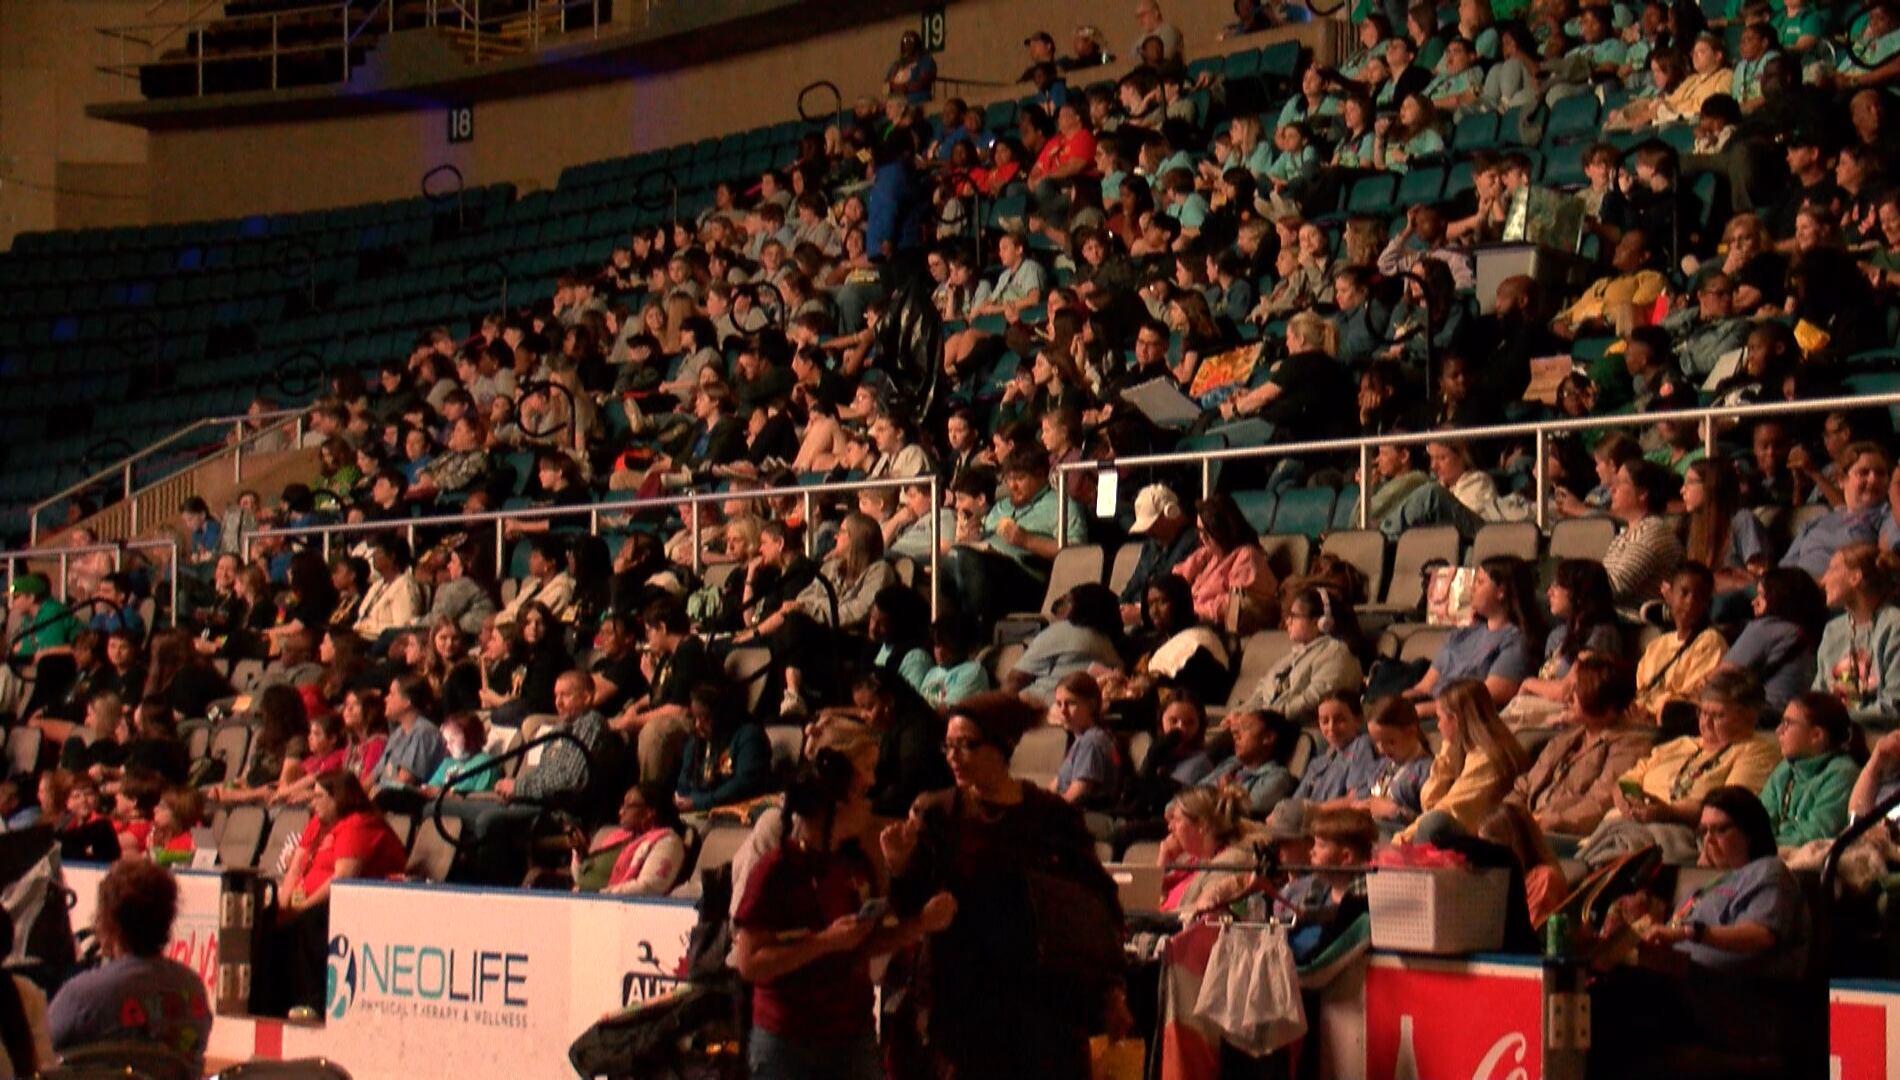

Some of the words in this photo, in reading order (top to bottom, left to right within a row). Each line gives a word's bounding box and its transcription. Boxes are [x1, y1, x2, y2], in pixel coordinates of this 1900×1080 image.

[924, 13, 944, 49] 19
[452, 107, 472, 139] 18
[361, 942, 529, 1007] NEOLIFE
